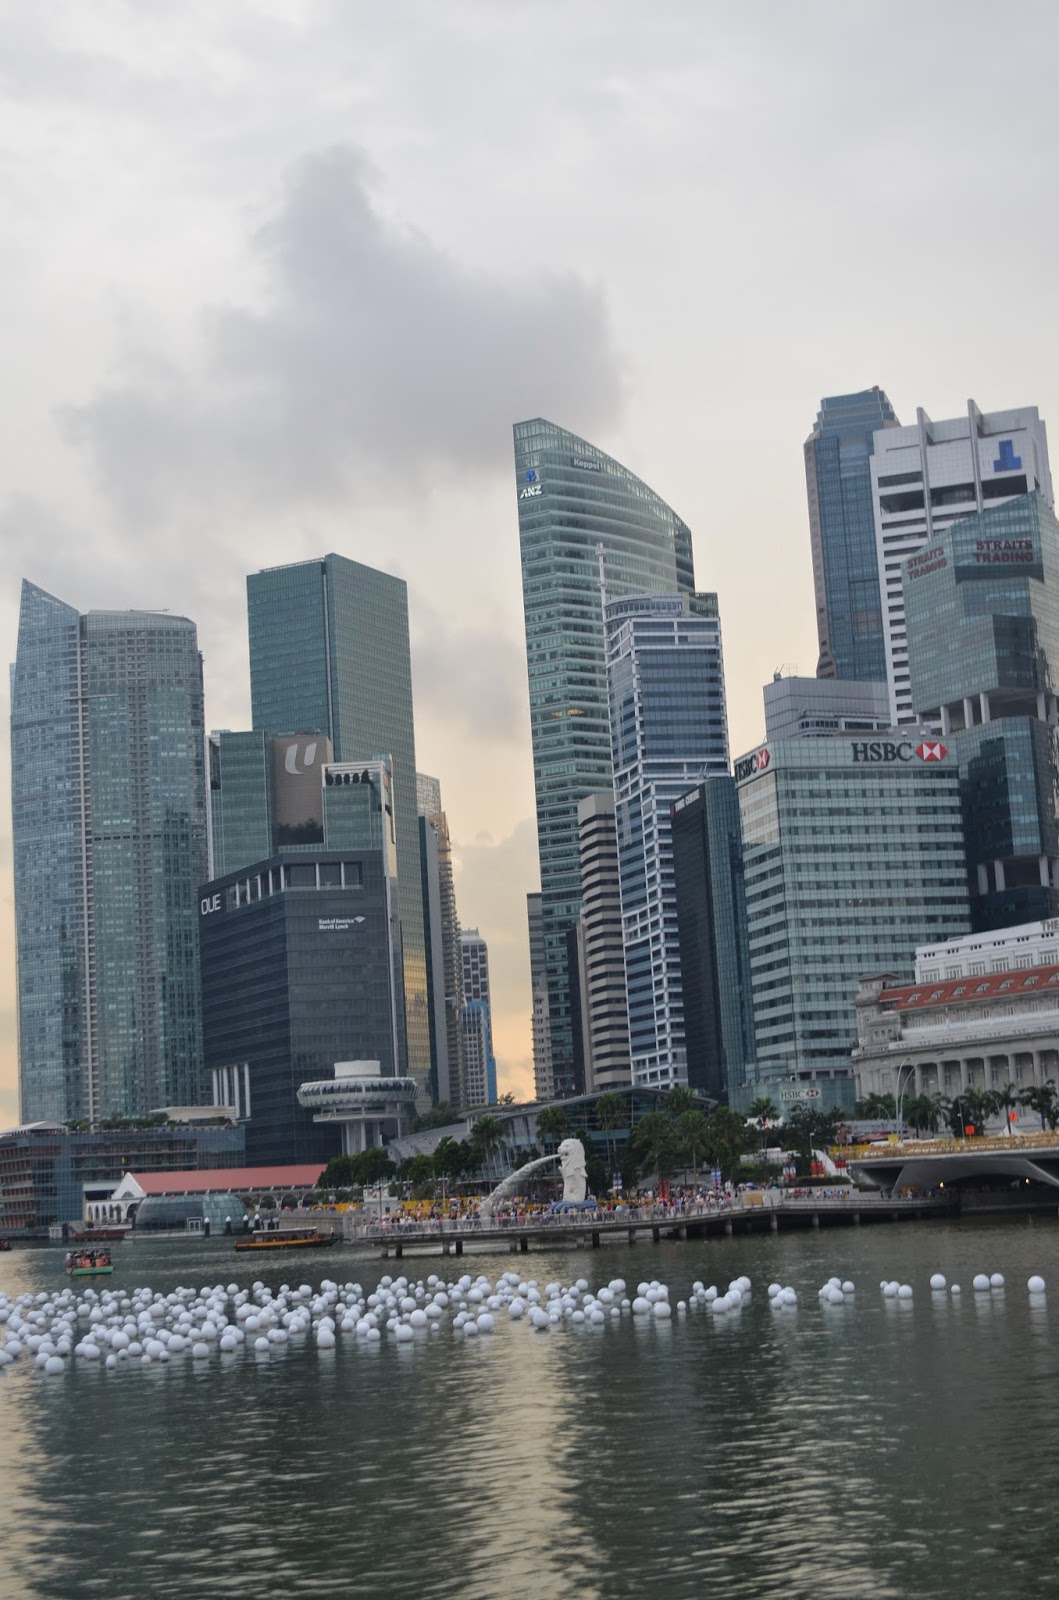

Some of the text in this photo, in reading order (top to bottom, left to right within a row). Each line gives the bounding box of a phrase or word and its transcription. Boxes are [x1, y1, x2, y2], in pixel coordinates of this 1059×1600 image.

[573, 458, 600, 470] Keppel
[520, 485, 542, 499] ANZ
[976, 540, 1033, 551] STRAITS
[907, 546, 945, 569] STRAITS
[976, 552, 1034, 563] TRADING
[908, 558, 948, 580] TRADING
[851, 742, 913, 762] HSBC
[735, 754, 757, 783] HSBC
[201, 893, 221, 915] OUE
[1040, 919, 1059, 932] THE
[781, 1090, 805, 1099] HSBC
